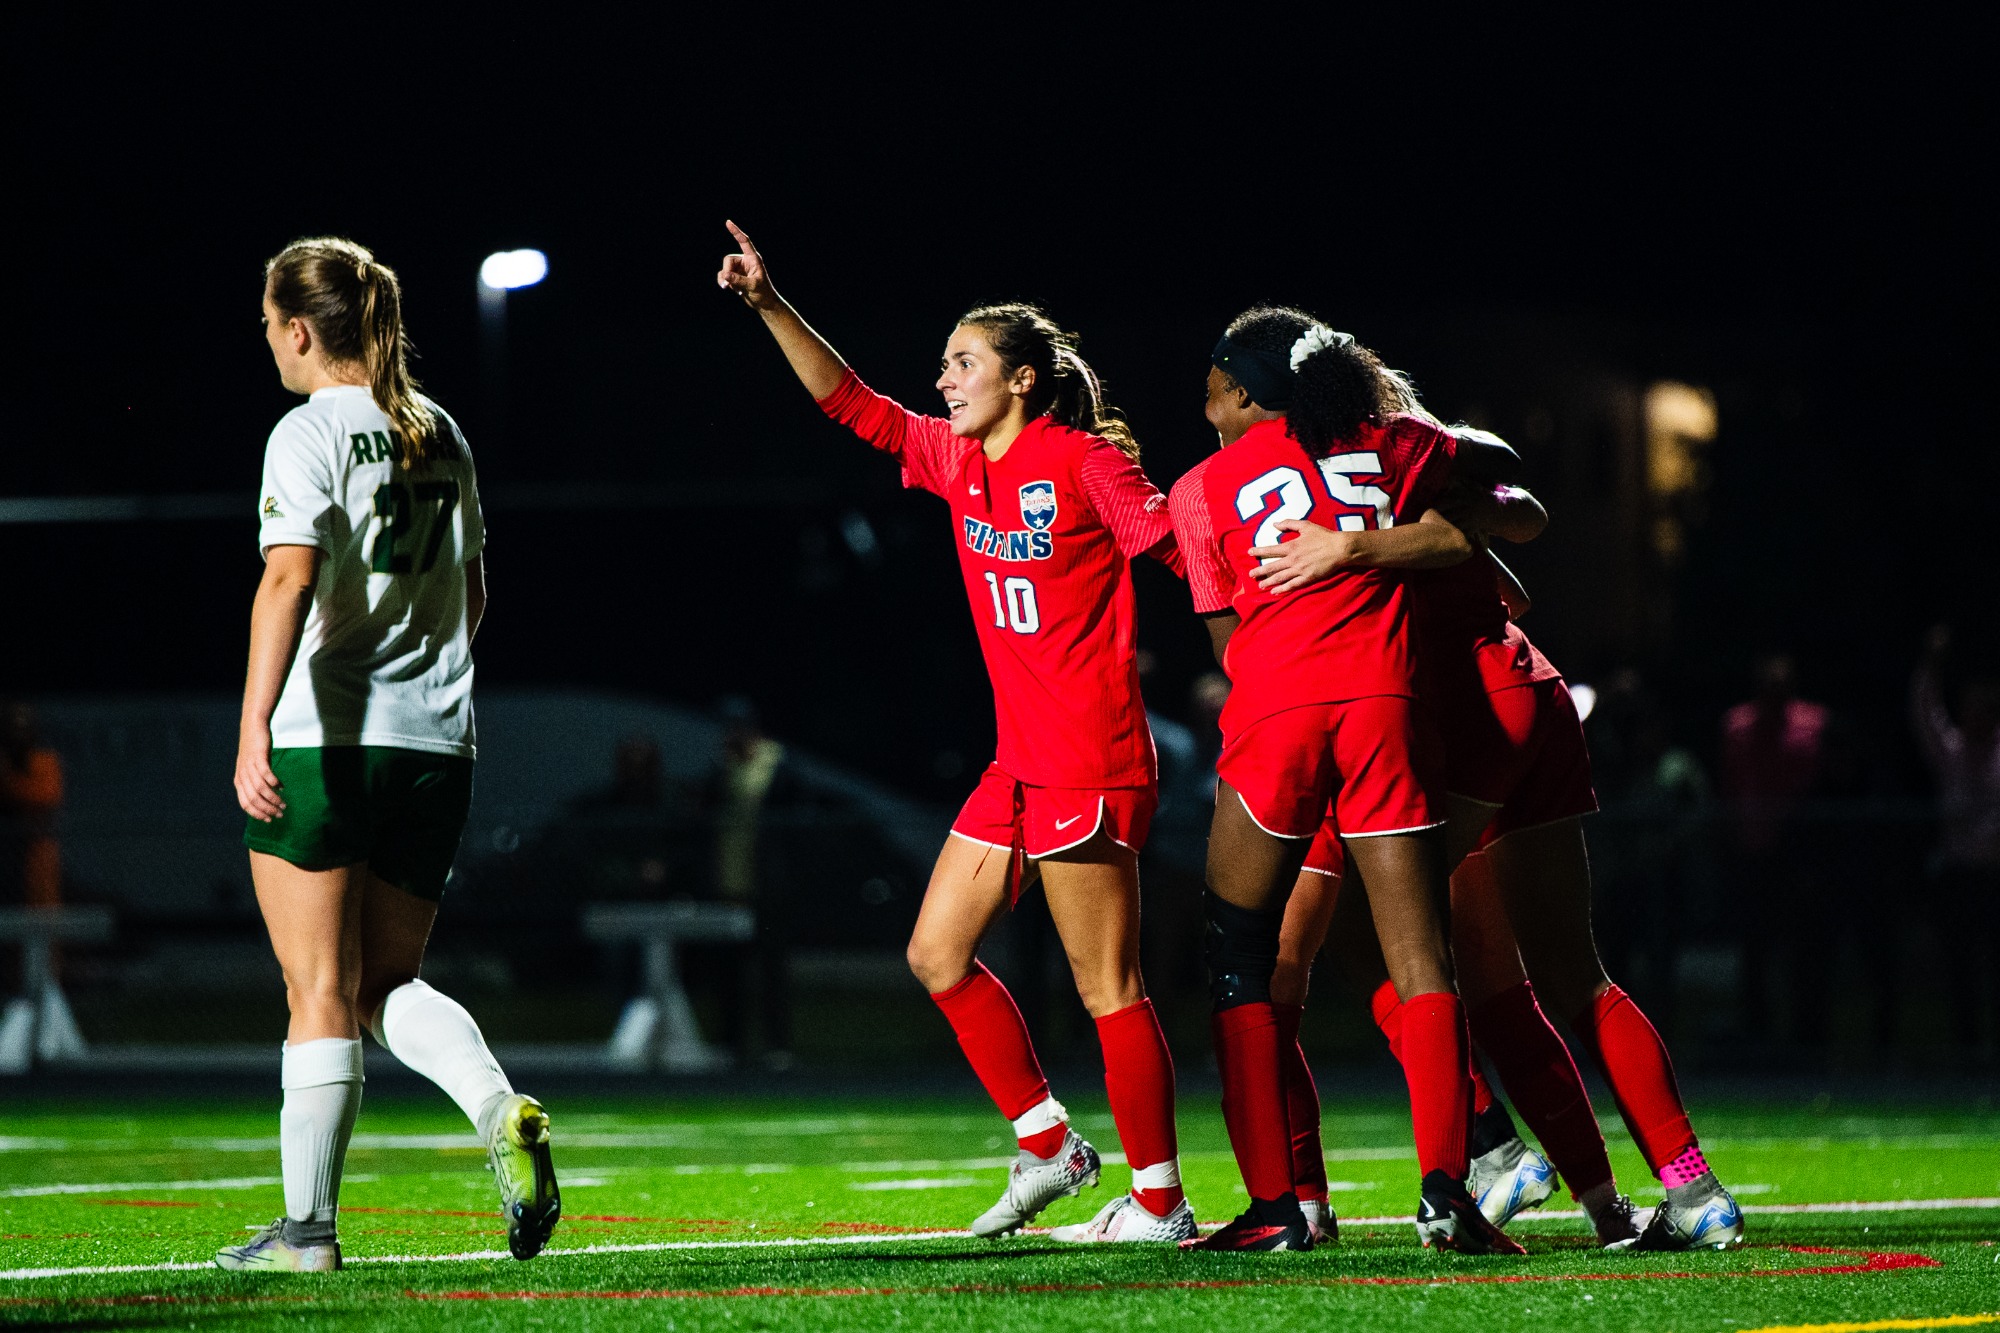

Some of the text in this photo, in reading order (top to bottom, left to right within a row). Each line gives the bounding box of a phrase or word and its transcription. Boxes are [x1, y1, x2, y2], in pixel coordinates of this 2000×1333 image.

[372, 482, 460, 573] 27
[1234, 450, 1397, 575] 25
[984, 570, 1041, 635] 10
